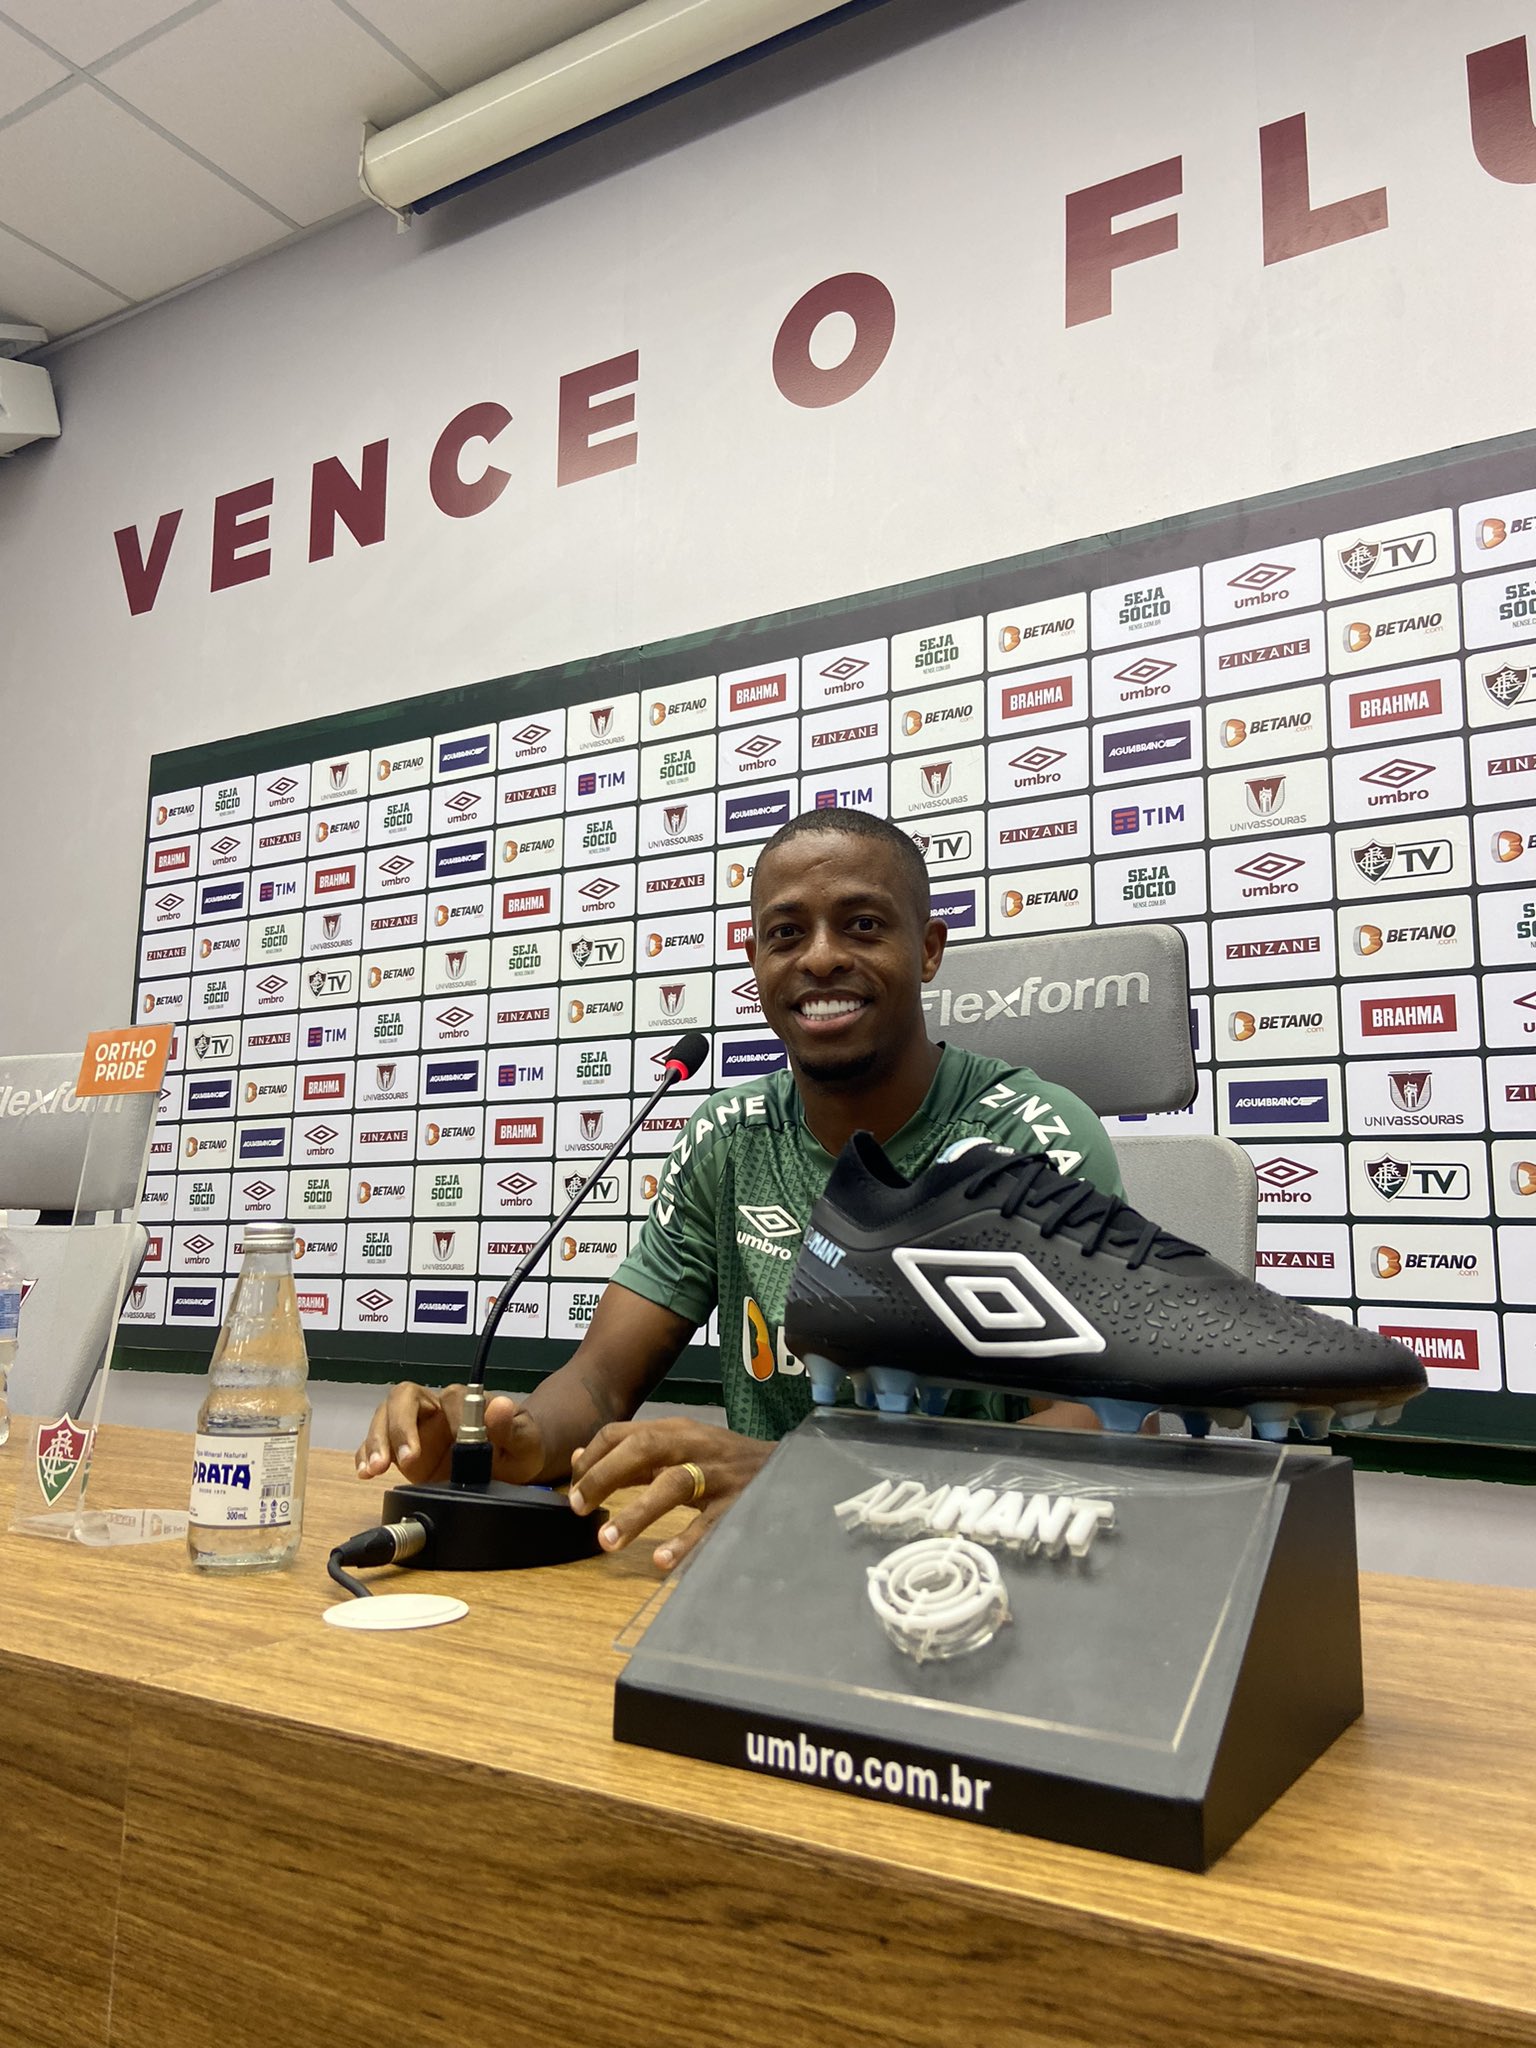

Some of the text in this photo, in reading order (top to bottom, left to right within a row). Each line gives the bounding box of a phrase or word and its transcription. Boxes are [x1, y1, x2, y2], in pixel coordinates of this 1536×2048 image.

[113, 349, 640, 617] VENCE
[771, 271, 896, 410] O
[1382, 539, 1423, 567] TV
[1124, 586, 1164, 607] SEJA
[1234, 589, 1289, 609] umbro
[1023, 618, 1074, 639] BETANO
[1375, 613, 1442, 637] BETANO
[919, 634, 954, 652] SEJA
[1221, 641, 1307, 668] ZINZANE
[736, 682, 778, 704] BRAHMA
[824, 680, 864, 695] umbro
[1120, 684, 1171, 701] umbro
[1010, 686, 1062, 710] BRAHMA
[1360, 691, 1429, 718] BRAHMA
[668, 698, 707, 715] BETANO
[924, 704, 973, 724] BETANO
[1250, 712, 1311, 734] BETANO
[813, 725, 876, 745] ZINZANE
[515, 745, 547, 758] umbro
[663, 749, 692, 765] SEJA
[392, 756, 424, 771] BETANO
[738, 758, 776, 772] umbro
[598, 771, 625, 788] TIM
[1014, 772, 1061, 788] umbro
[218, 787, 238, 800] SEJA
[506, 786, 554, 802] ZINZANE
[839, 787, 872, 808] TIM
[1367, 789, 1429, 806] umbro
[268, 796, 295, 807] umbro
[387, 802, 410, 815] SEJA
[168, 804, 195, 817] BETANO
[447, 812, 477, 824] umbro
[1142, 804, 1184, 826] TIM
[329, 820, 360, 834] BETANO
[586, 820, 613, 834] SEJA
[999, 822, 1075, 842] ZINZANE
[259, 832, 299, 847] ZINZANE
[519, 838, 555, 853] BETANO
[933, 832, 963, 858] TV
[158, 852, 185, 867] BRAHMA
[212, 855, 237, 866] umbro
[1397, 842, 1439, 872] TV
[319, 872, 350, 888] BRAHMA
[381, 876, 410, 887] umbro
[1128, 865, 1170, 883] SEJA
[275, 881, 296, 896] TIM
[648, 875, 703, 891] ZINZANE
[1242, 882, 1298, 897] umbro
[508, 895, 544, 912] BRAHMA
[1026, 888, 1078, 906] BETANO
[450, 904, 484, 918] BETANO
[581, 901, 616, 912] umbro
[156, 912, 181, 922] umbro
[372, 915, 416, 929] ZINZANE
[264, 924, 285, 936] SEJA
[1386, 924, 1456, 943] BETANO
[212, 938, 240, 950] BETANO
[664, 933, 704, 947] BETANO
[148, 948, 184, 960] ZINZANE
[512, 943, 538, 956] SEJA
[594, 939, 618, 961] TV
[1229, 939, 1317, 957] ZINZANE
[382, 966, 415, 980] BETANO
[206, 980, 227, 992] SEJA
[327, 971, 347, 991] TV
[155, 994, 183, 1006] BETANO
[258, 995, 284, 1005] umbro
[585, 1001, 624, 1014] BETANO
[377, 1012, 401, 1024] SEJA
[498, 1009, 548, 1022] ZINZANE
[1259, 1013, 1322, 1030] BETANO
[1372, 1005, 1443, 1027] BRAHMA
[249, 1034, 289, 1045] ZINZANE
[324, 1028, 347, 1042] TIM
[438, 1029, 469, 1039] umbro
[95, 1039, 157, 1062] ORTHO
[211, 1036, 229, 1054] TV
[580, 1051, 608, 1064] SEJA
[94, 1060, 148, 1082] PRIDE
[518, 1066, 544, 1082] TIM
[258, 1084, 288, 1095] BETANO
[308, 1080, 339, 1094] BRAHMA
[360, 1131, 406, 1142] ZINZANE
[441, 1126, 475, 1138] BETANO
[500, 1124, 537, 1139] BRAHMA
[979, 1082, 1085, 1178] ZINZA
[198, 1139, 227, 1150] BETANO
[306, 1146, 334, 1156] umbro
[307, 1179, 330, 1190] SEJA
[435, 1174, 460, 1186] SEJA
[1412, 1164, 1456, 1194] TV
[192, 1182, 213, 1193] SEJA
[372, 1185, 405, 1196] BETANO
[244, 1202, 271, 1211] umbro
[500, 1196, 533, 1206] umbro
[366, 1232, 390, 1243] SEJA
[306, 1242, 338, 1252] BETANO
[578, 1242, 617, 1253] BETANO
[736, 1230, 792, 1261] umbro
[184, 1255, 210, 1264] umbro
[1260, 1253, 1332, 1268] NZANE
[1405, 1254, 1477, 1269] BETANO
[358, 1312, 389, 1322] umbro
[833, 1479, 1115, 1552] ADAMANT
[745, 1728, 991, 1814] umbro.com.br
